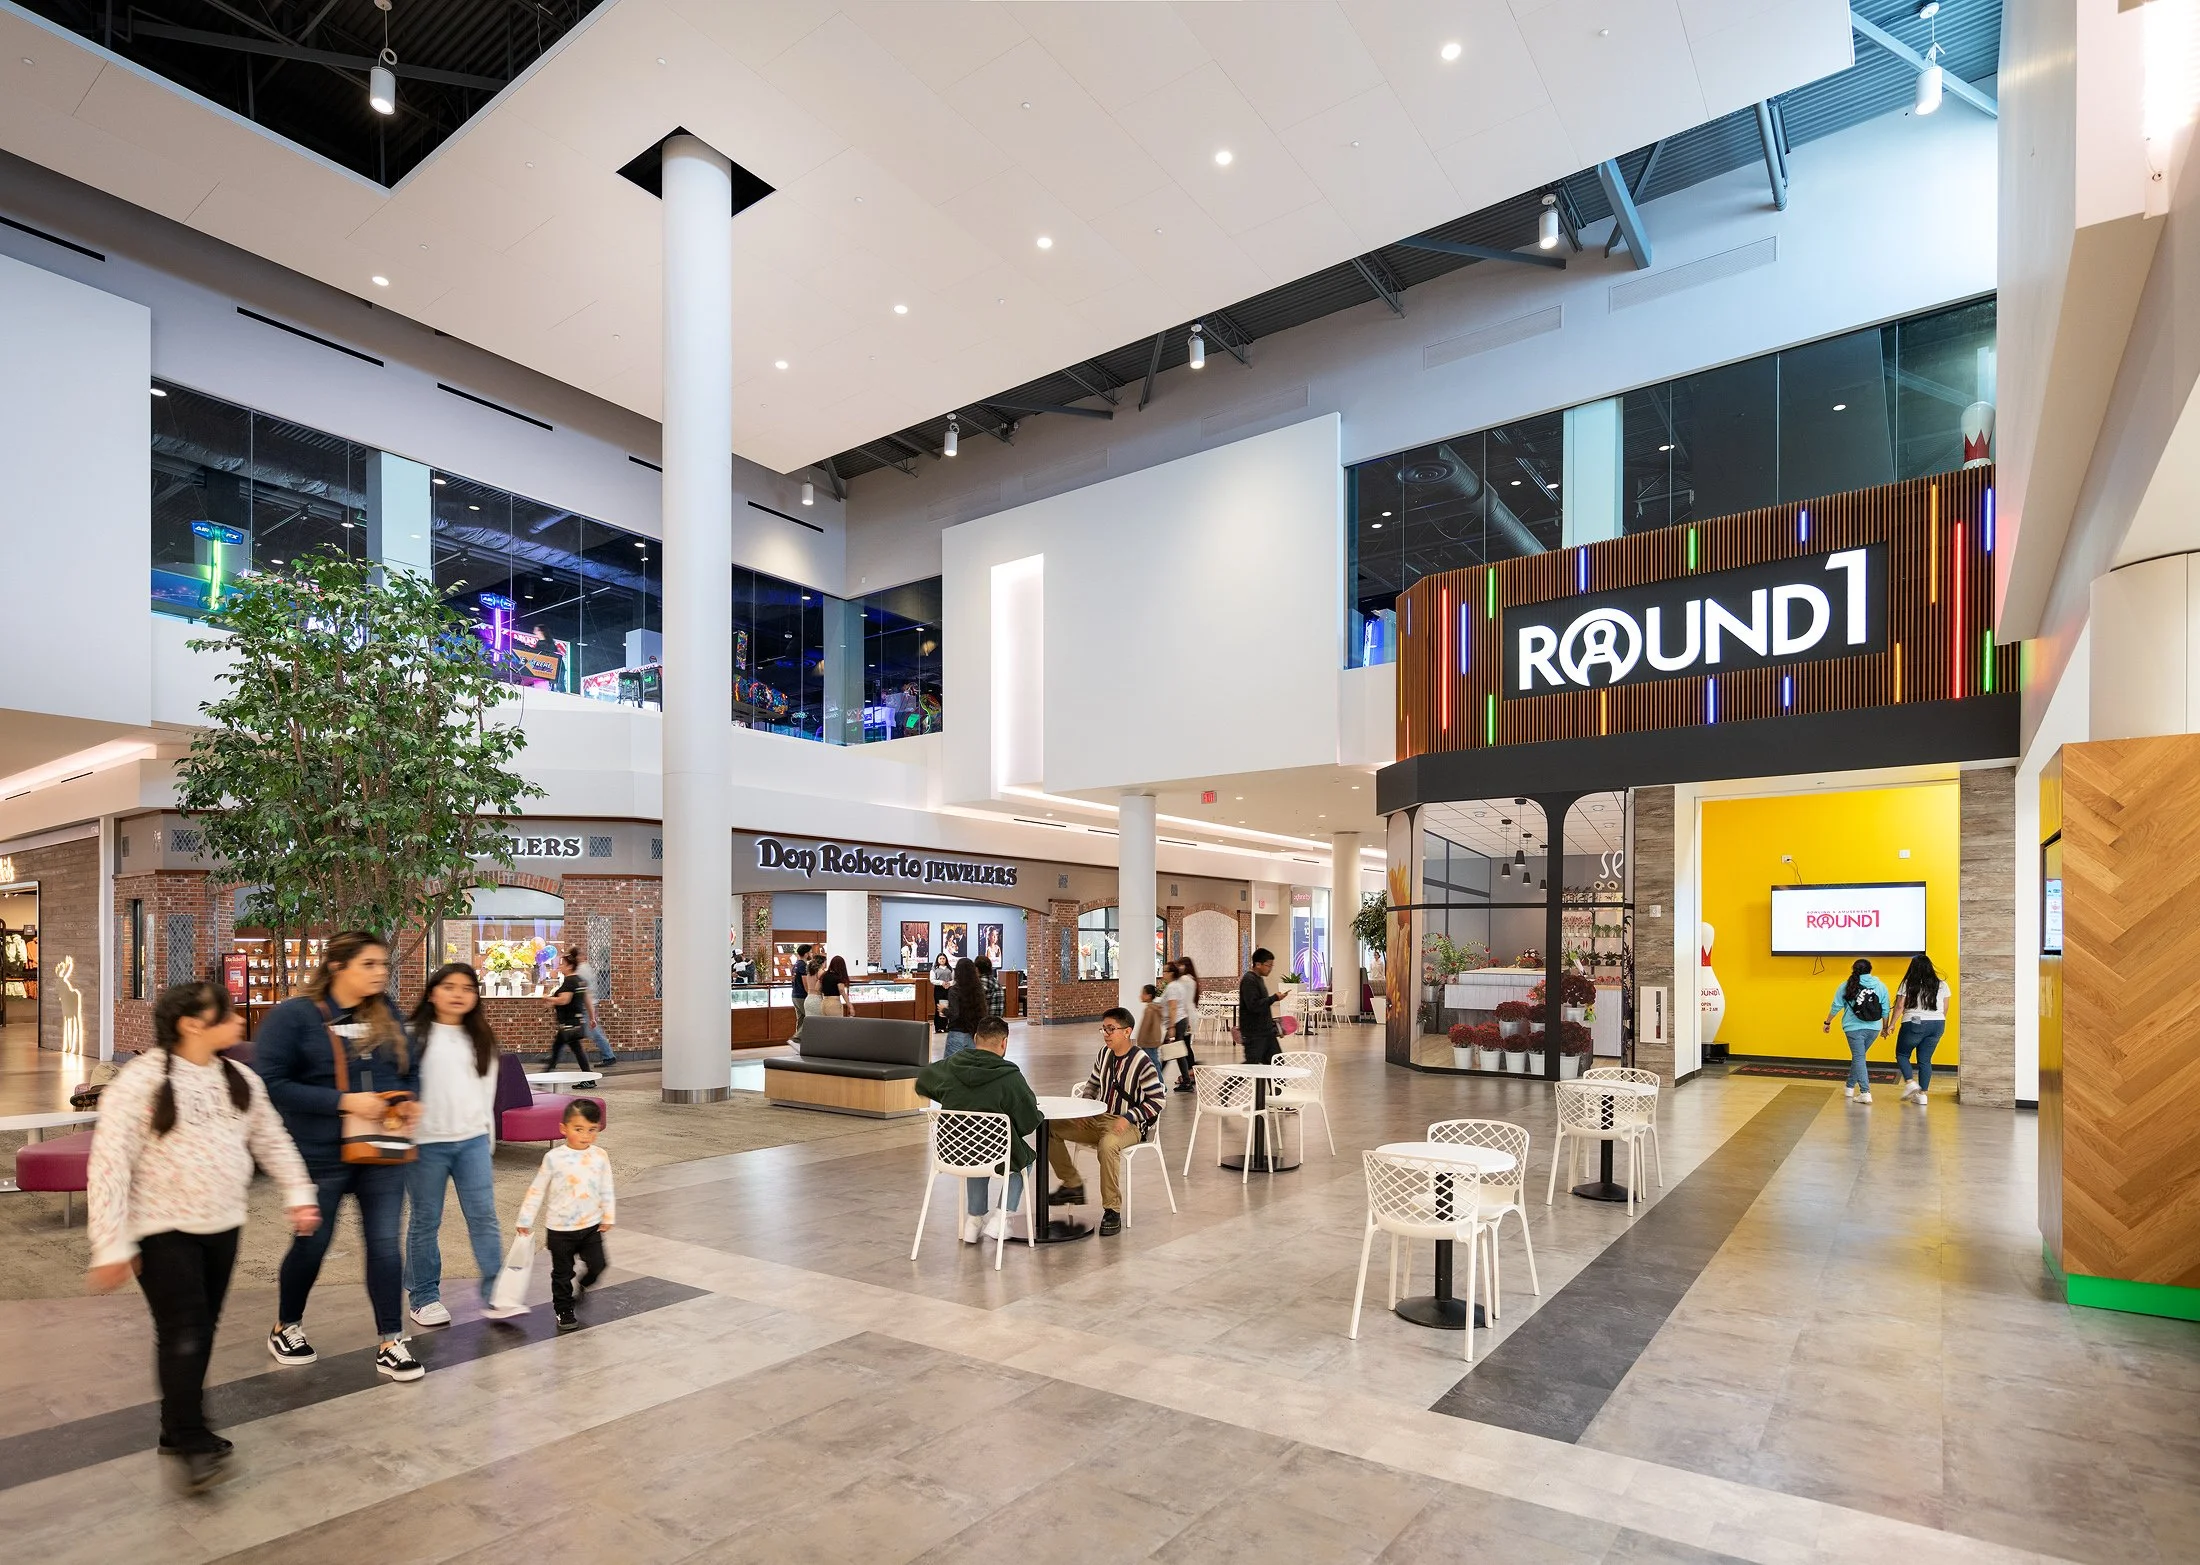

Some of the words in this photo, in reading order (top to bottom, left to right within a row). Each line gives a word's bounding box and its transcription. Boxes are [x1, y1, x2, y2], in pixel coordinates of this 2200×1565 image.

[1518, 548, 1867, 691] ROUND1
[756, 838, 817, 878] Don
[818, 844, 922, 878] Roberto
[924, 860, 1018, 886] JEWELERS
[1807, 910, 1879, 928] ROUND1
